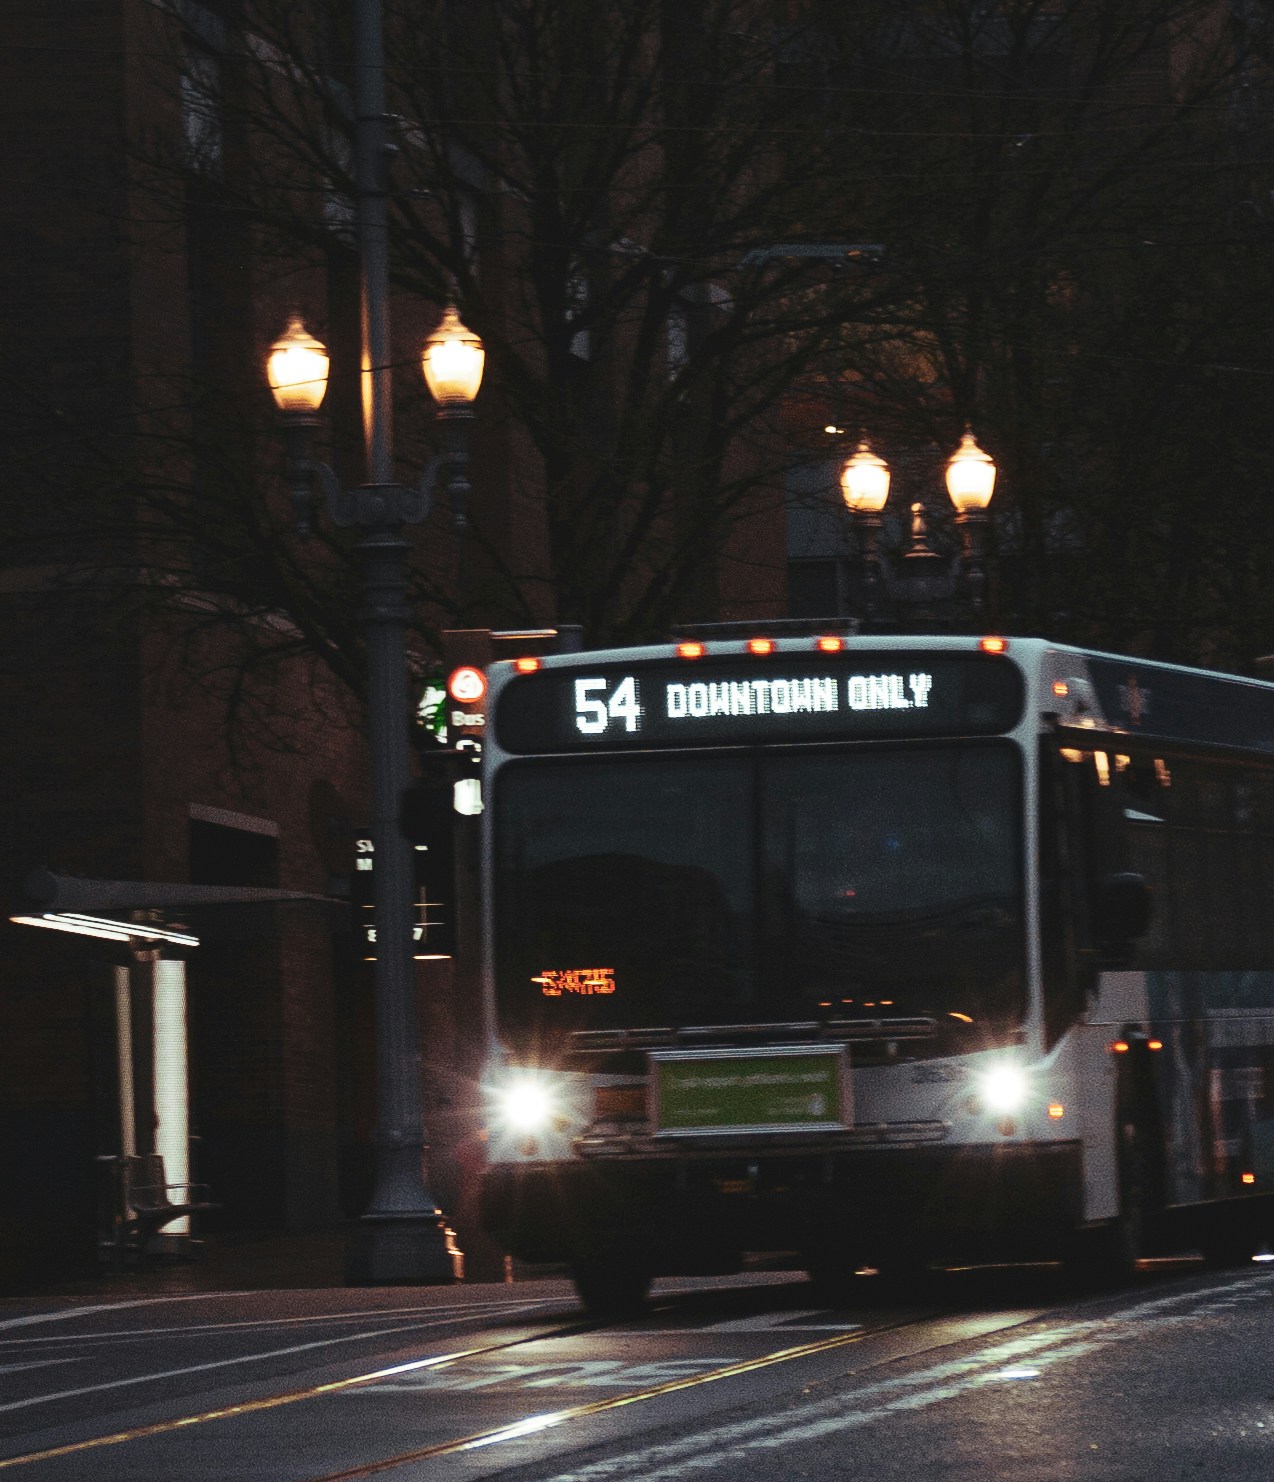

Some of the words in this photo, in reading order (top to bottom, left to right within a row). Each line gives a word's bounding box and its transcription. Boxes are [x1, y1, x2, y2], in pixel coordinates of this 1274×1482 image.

[451, 710, 486, 727] Bus
[574, 677, 643, 734] 54
[667, 678, 839, 718] DOWNTOWN
[848, 673, 932, 711] ONLY
